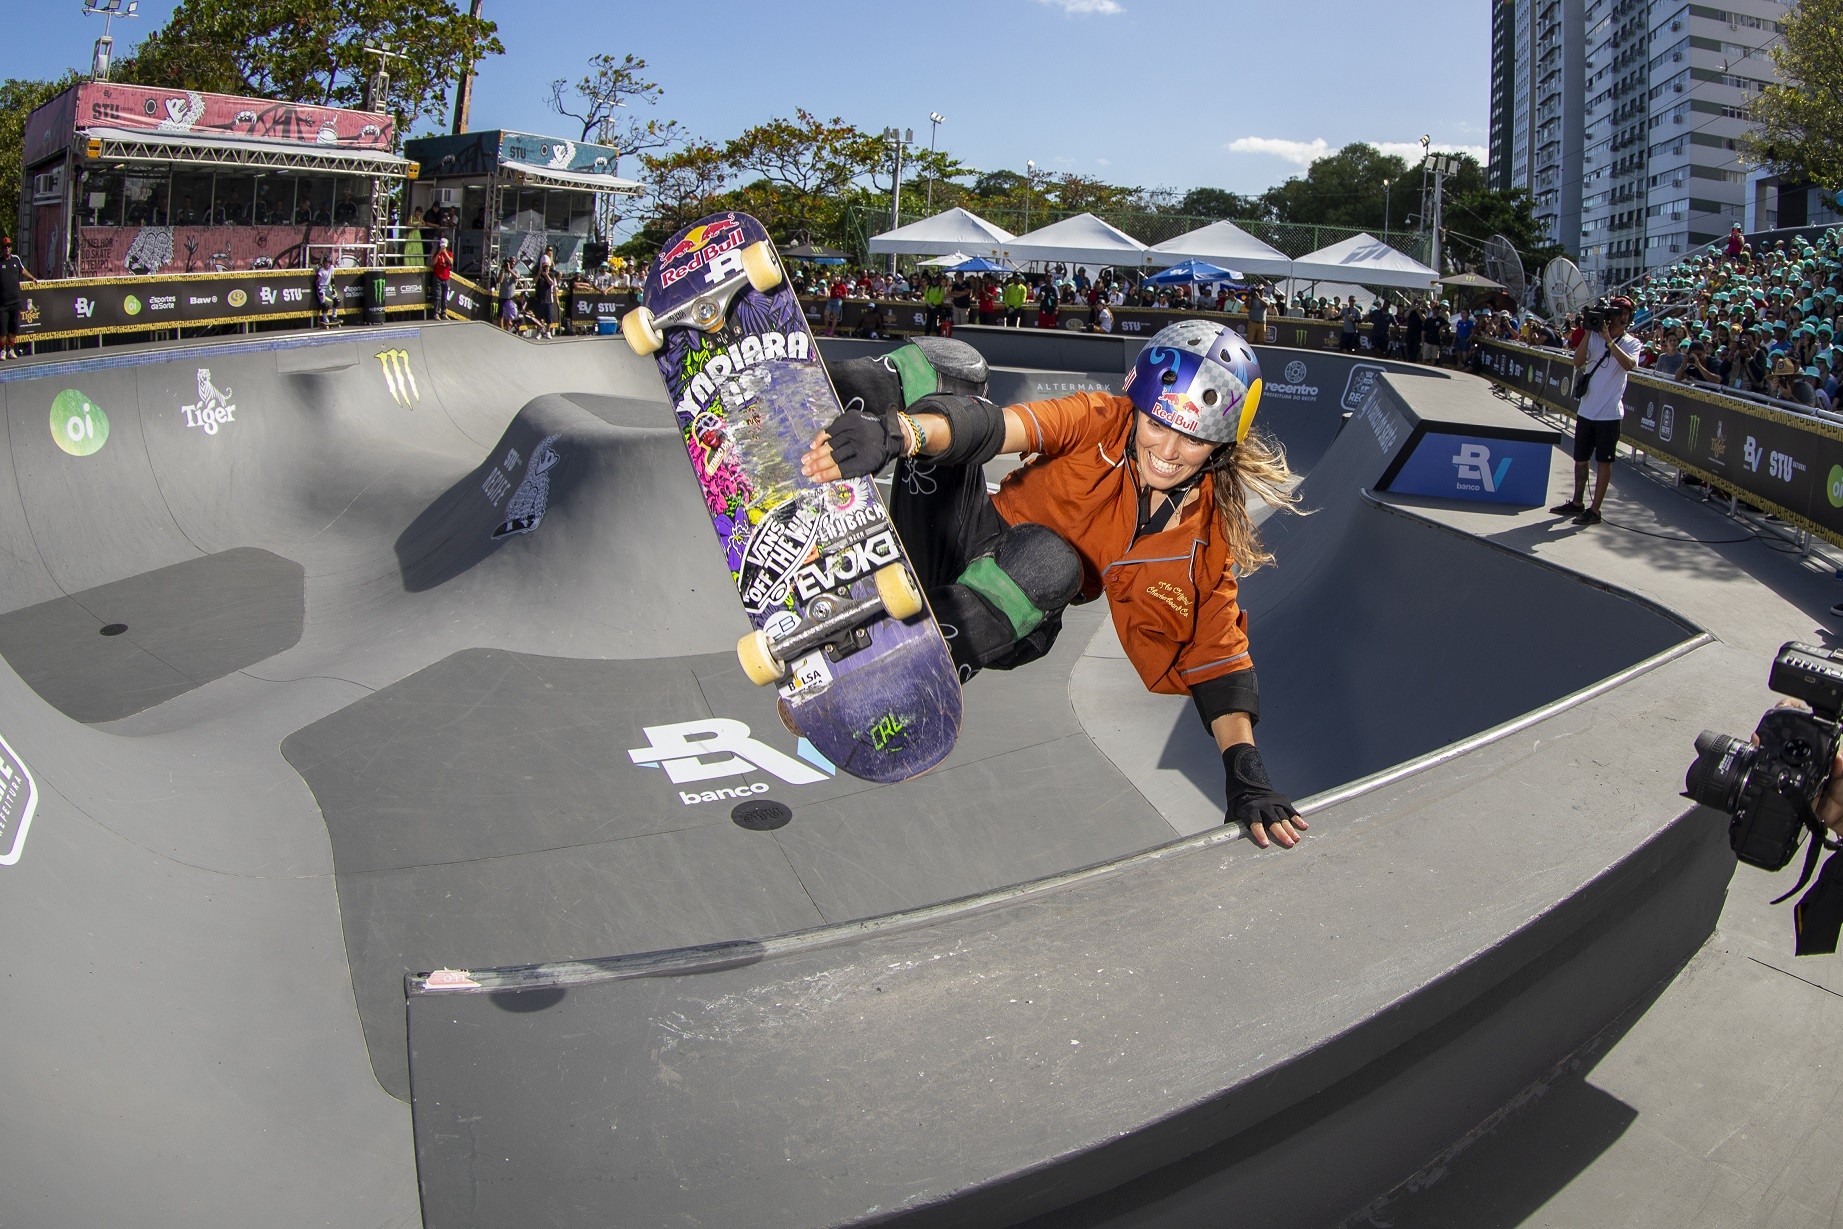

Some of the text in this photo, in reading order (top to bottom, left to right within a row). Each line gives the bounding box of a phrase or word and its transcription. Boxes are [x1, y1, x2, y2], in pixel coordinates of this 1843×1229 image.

[92, 103, 120, 120] STU
[510, 146, 526, 159] STU
[660, 250, 703, 289] Red
[702, 228, 745, 264] Bull
[190, 296, 211, 304] Baw
[282, 288, 302, 302] STU
[458, 294, 473, 310] STU
[598, 302, 616, 312] STU
[20, 310, 40, 323] Tiger
[1122, 320, 1141, 331] STU
[1037, 383, 1111, 391] ALTERMARK
[1264, 382, 1318, 396] recentro
[66, 402, 94, 442] oi
[181, 400, 236, 436] Tiger
[1152, 402, 1198, 432] Red Bull
[1770, 450, 1793, 483] STU
[1456, 482, 1480, 491] banco
[746, 516, 786, 567] VANS
[749, 568, 774, 602] OFF
[764, 534, 803, 576] THE
[1158, 581, 1173, 592] The
[679, 782, 770, 805] banco
